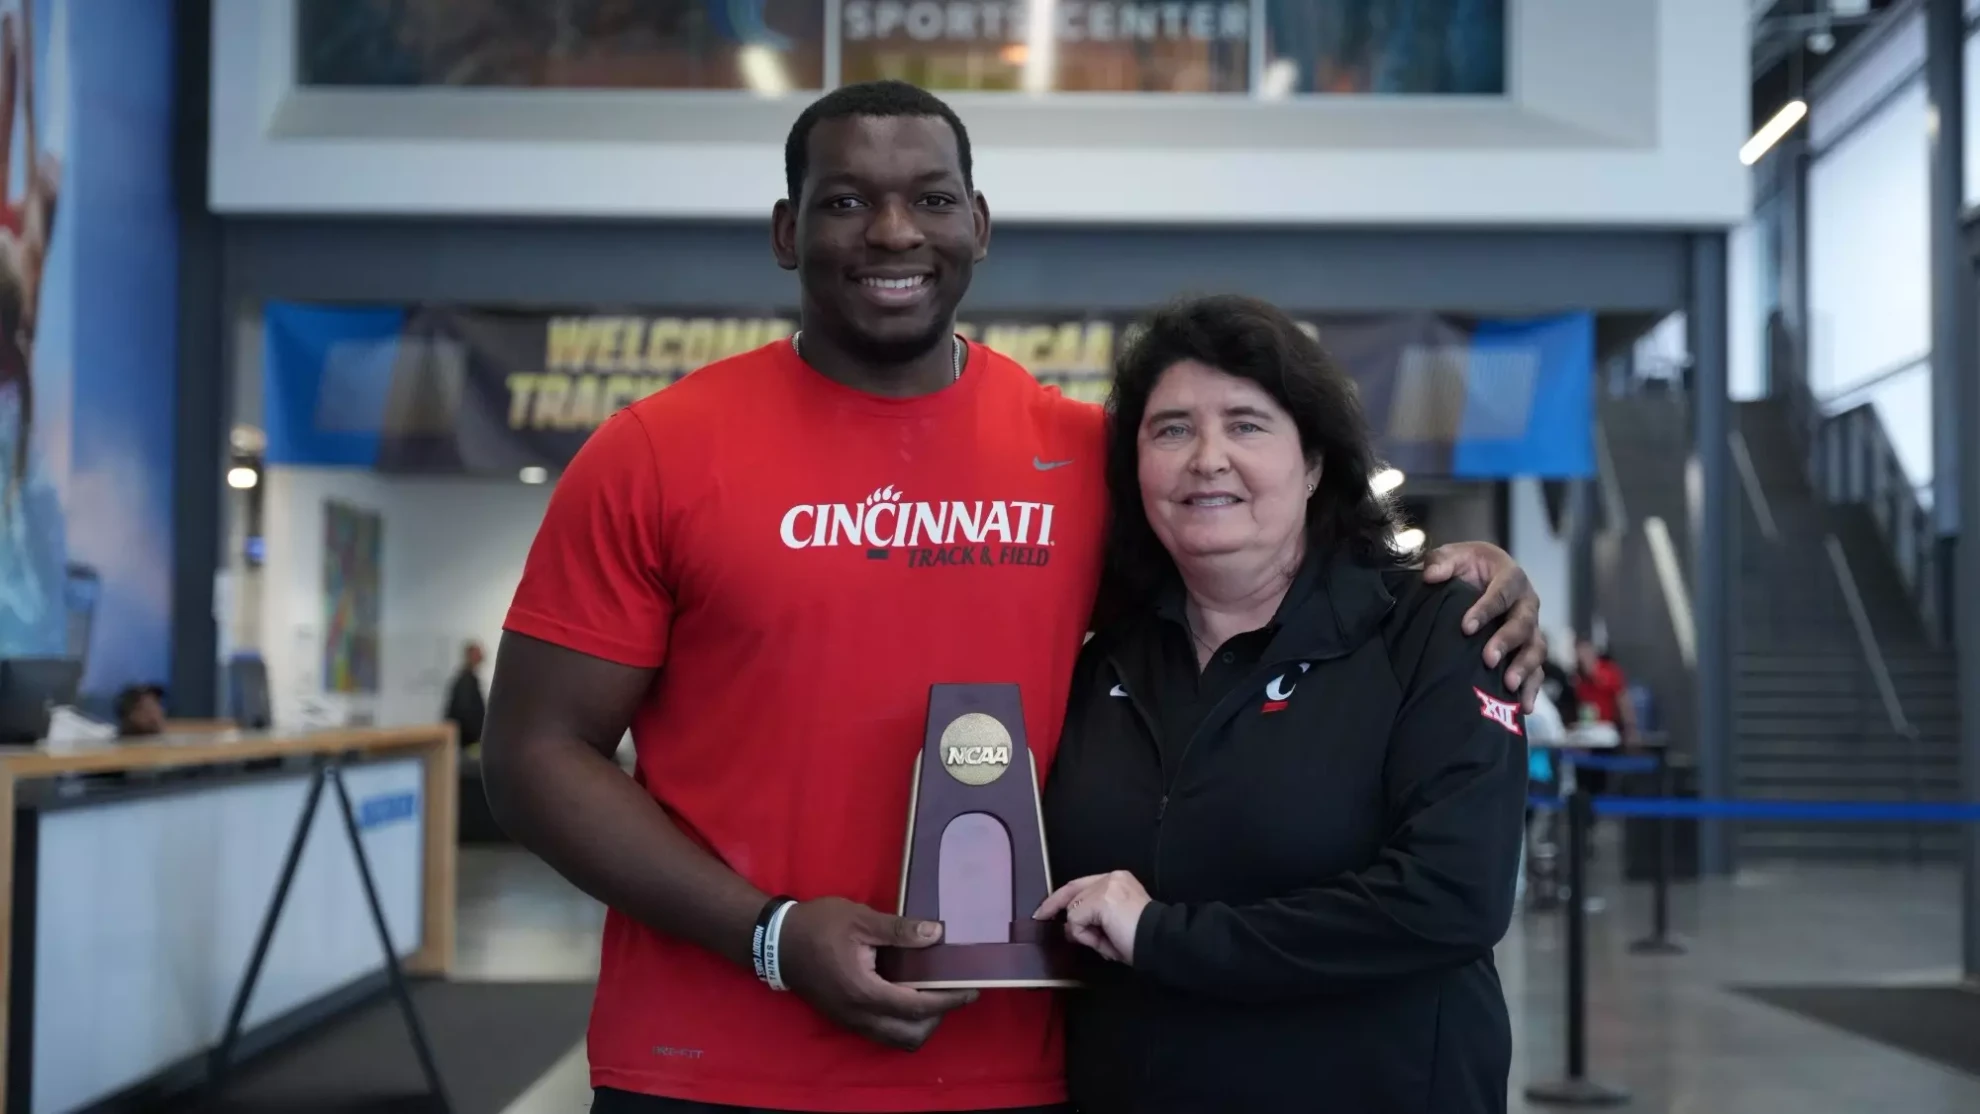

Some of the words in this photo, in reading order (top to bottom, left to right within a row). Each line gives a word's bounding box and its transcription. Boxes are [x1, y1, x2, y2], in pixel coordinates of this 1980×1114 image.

[1057, 2, 1248, 39] CENTER
[780, 500, 1055, 549] CINCINNATI
[907, 547, 977, 569] TRACK
[979, 546, 994, 567] &
[999, 546, 1050, 568] FIELD
[947, 746, 1009, 766] NCAA
[766, 944, 777, 981] THINGS
